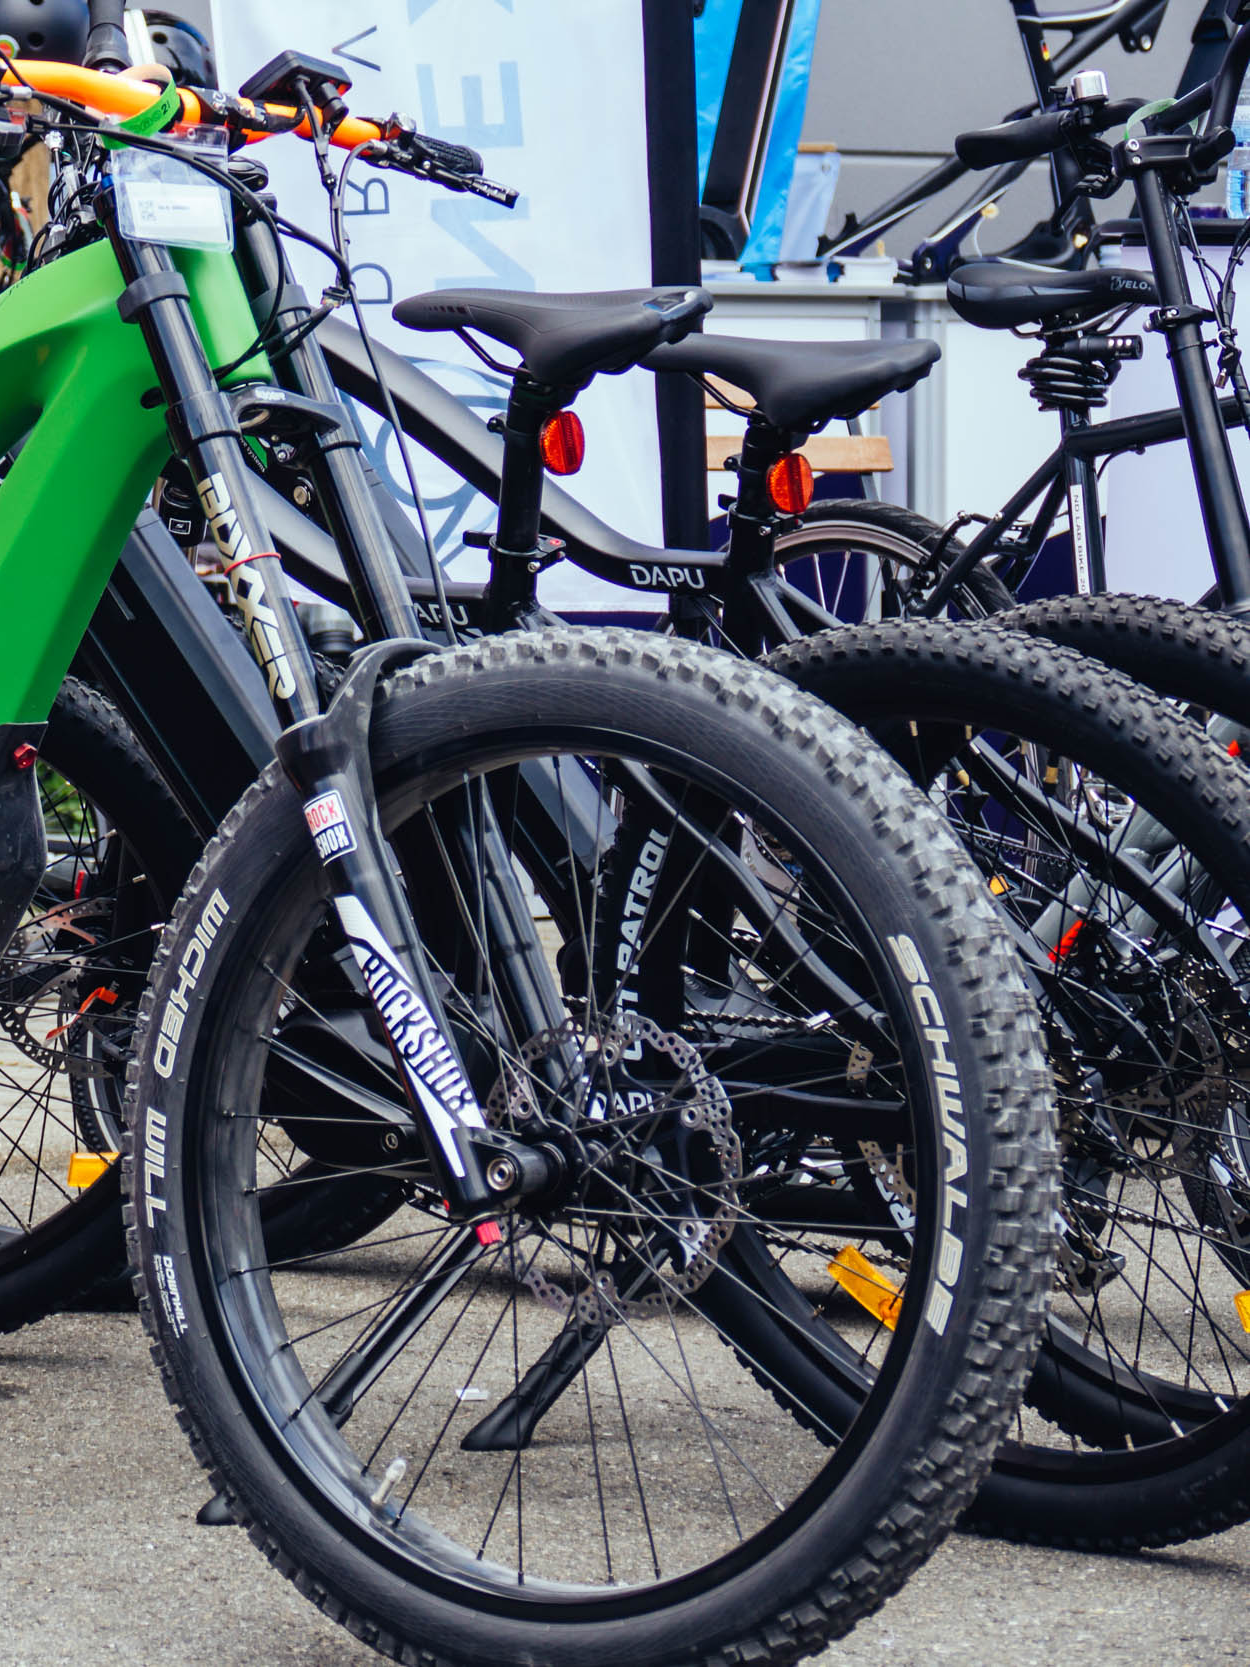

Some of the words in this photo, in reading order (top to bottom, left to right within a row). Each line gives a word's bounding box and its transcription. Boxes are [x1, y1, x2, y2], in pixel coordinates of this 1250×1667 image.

[413, 601, 469, 626] APU
[630, 564, 705, 589] DAPU
[306, 801, 339, 829] ROCK
[153, 888, 230, 1078] WICKED
[145, 1106, 167, 1228] WILL
[887, 933, 968, 1336] SCHWALBE
[162, 1255, 188, 1334] DOWNHILL
